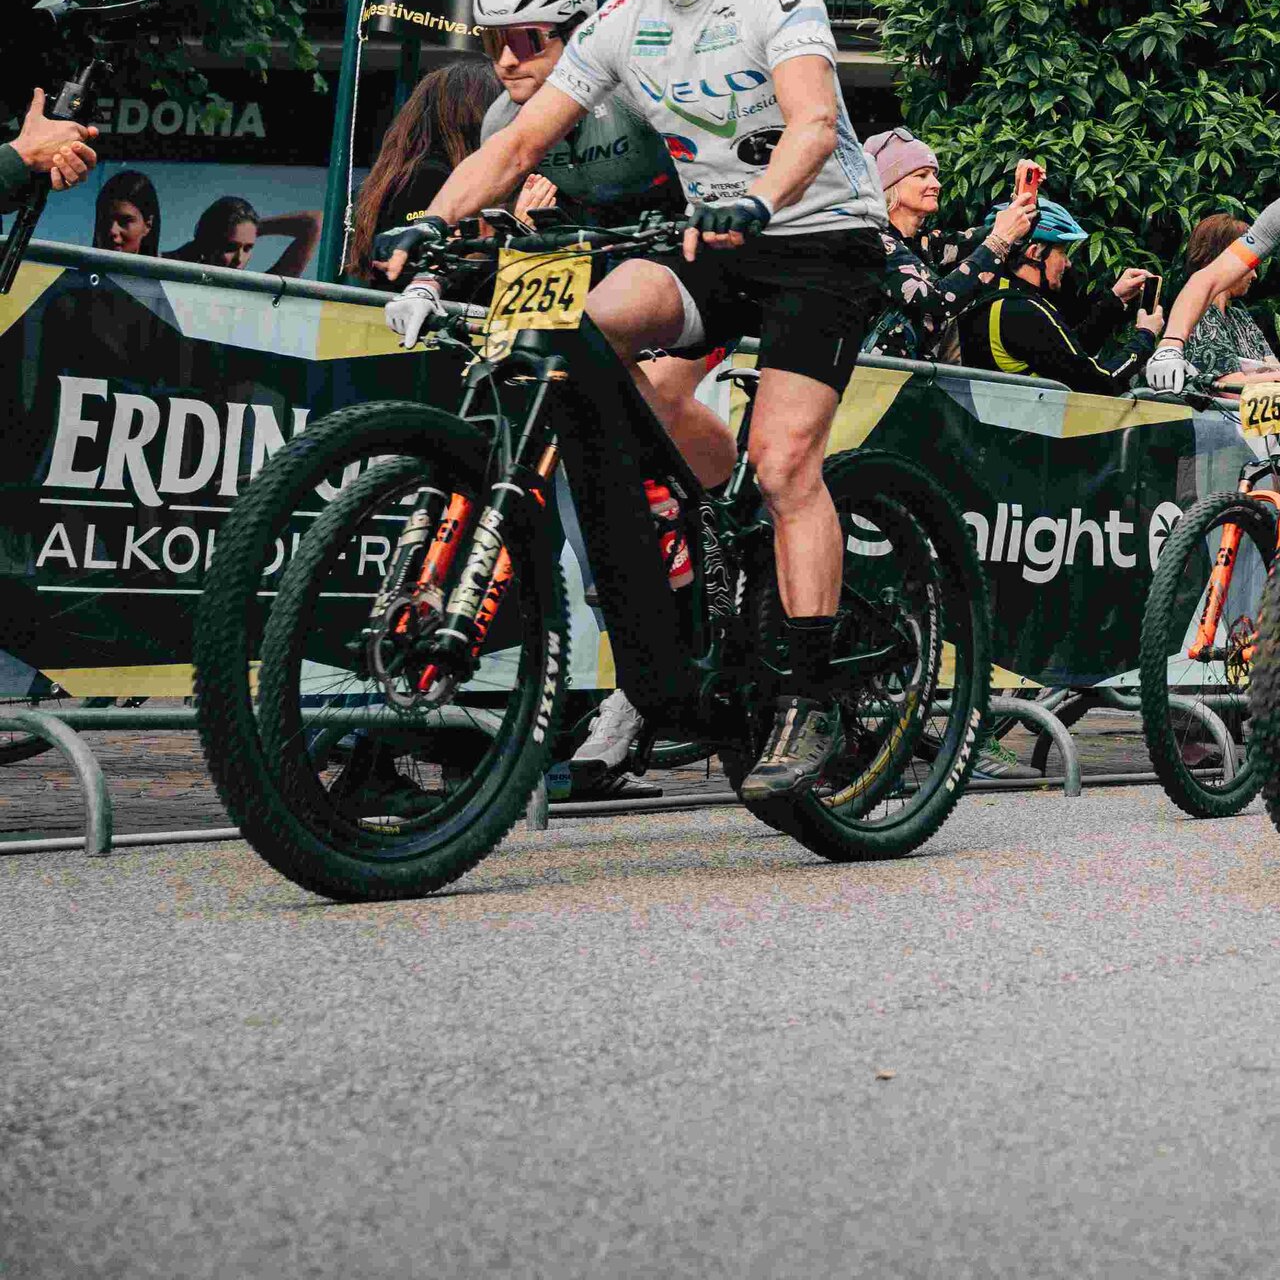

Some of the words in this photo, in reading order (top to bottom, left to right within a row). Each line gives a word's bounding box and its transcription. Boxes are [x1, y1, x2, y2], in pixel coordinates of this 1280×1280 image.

[627, 66, 768, 104] VELO
[500, 272, 575, 316] 2254
[42, 375, 419, 507] ERDIN
